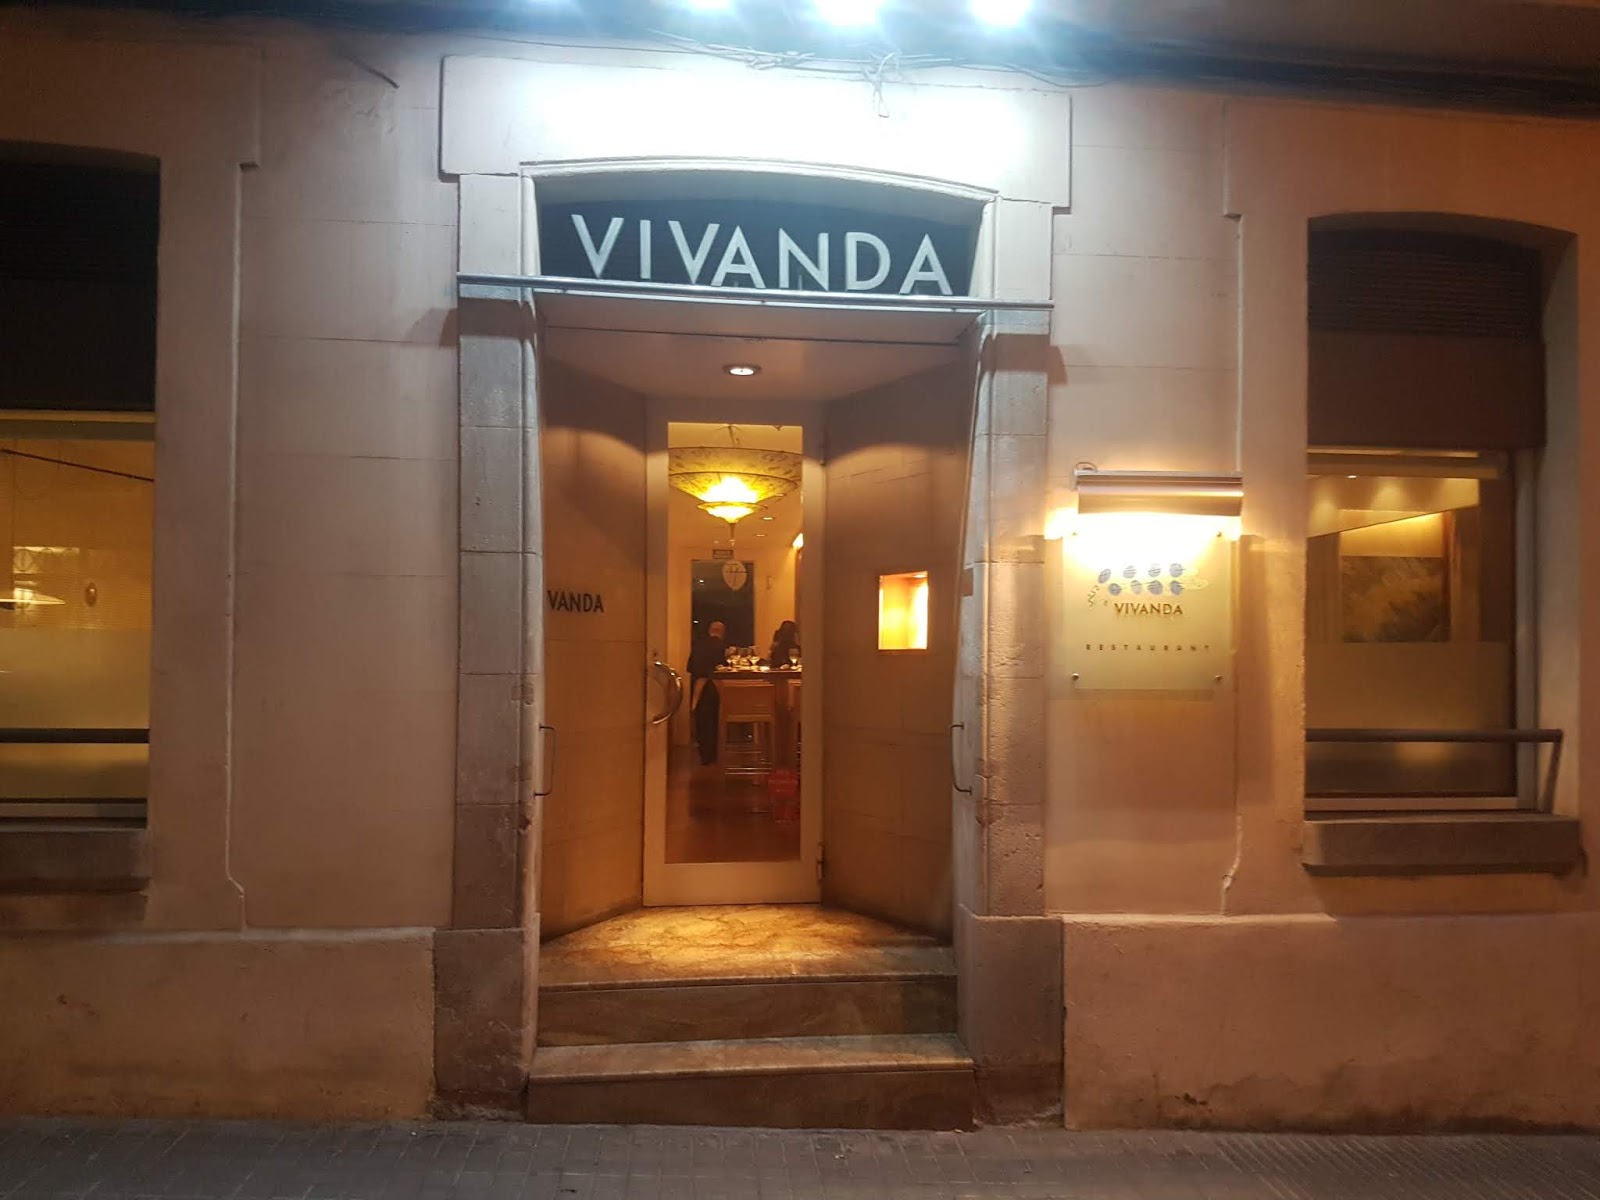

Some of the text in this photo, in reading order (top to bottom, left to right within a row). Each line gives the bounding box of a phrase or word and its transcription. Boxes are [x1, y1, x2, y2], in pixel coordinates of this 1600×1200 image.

[571, 214, 953, 295] VIVANDA
[1114, 602, 1183, 615] VIVANDA
[1086, 643, 1210, 651] RESTAURANT
